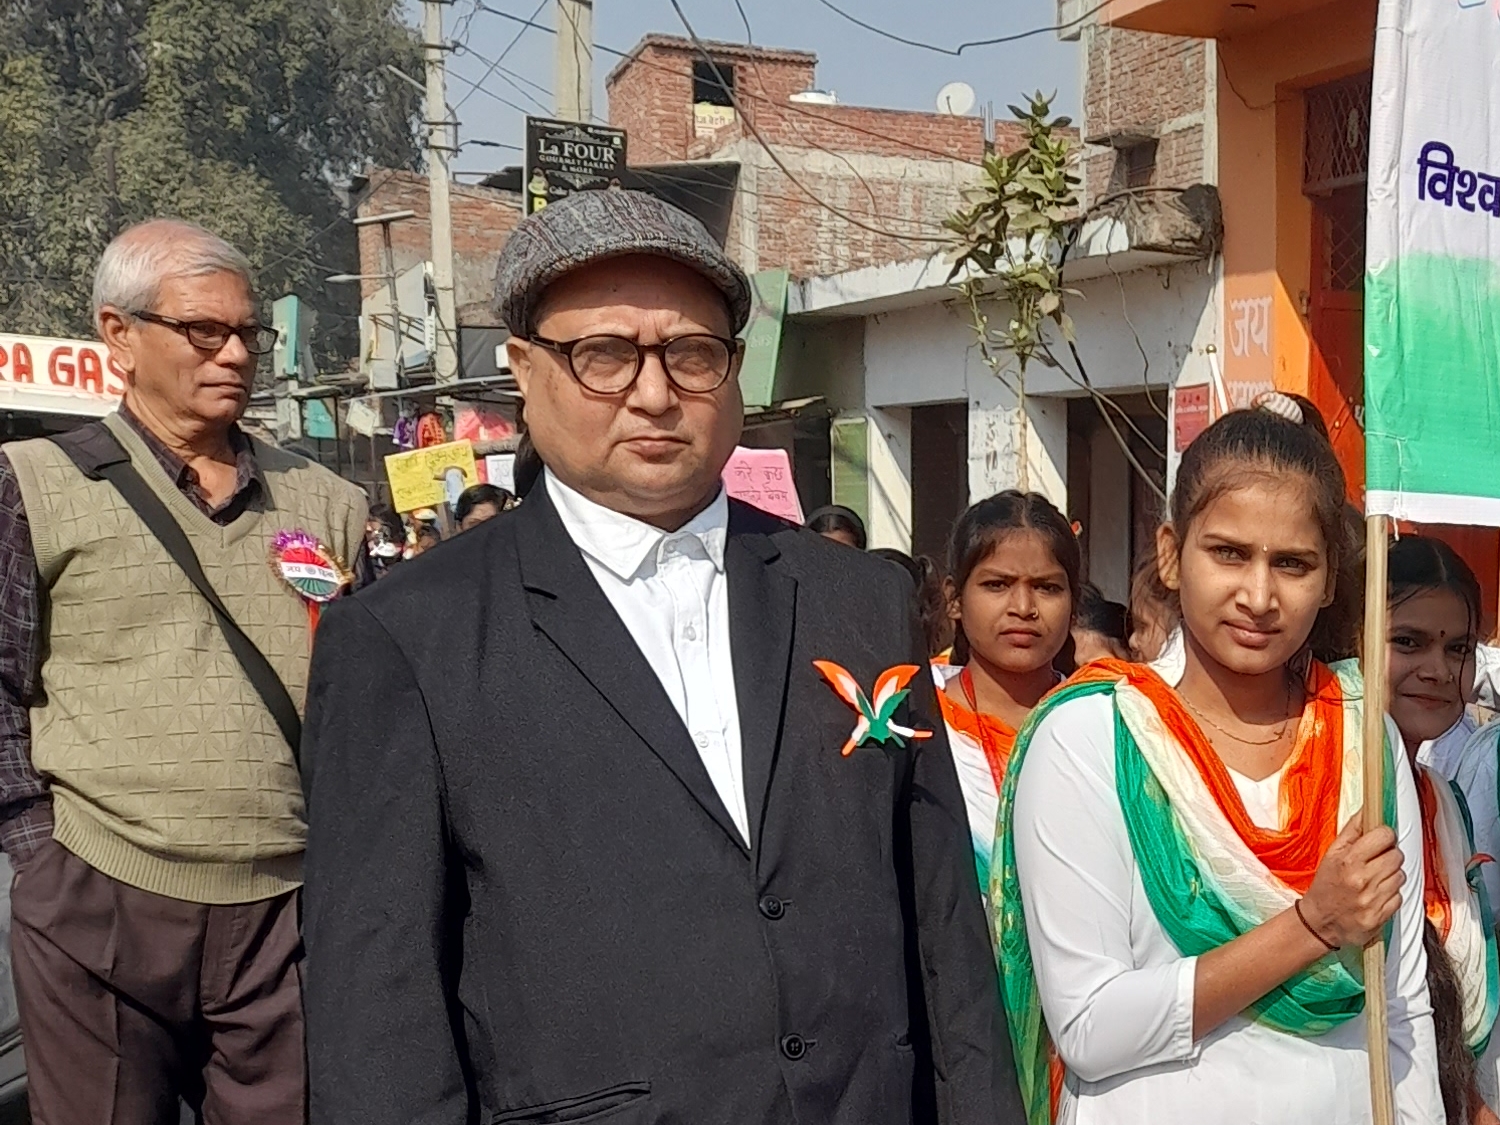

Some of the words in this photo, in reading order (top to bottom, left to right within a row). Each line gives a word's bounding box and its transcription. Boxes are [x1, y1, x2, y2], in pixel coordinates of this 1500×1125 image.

[538, 138, 559, 155] La
[563, 142, 617, 164] FOUR
[1229, 296, 1273, 357] जय
[48, 346, 128, 395] GAS
